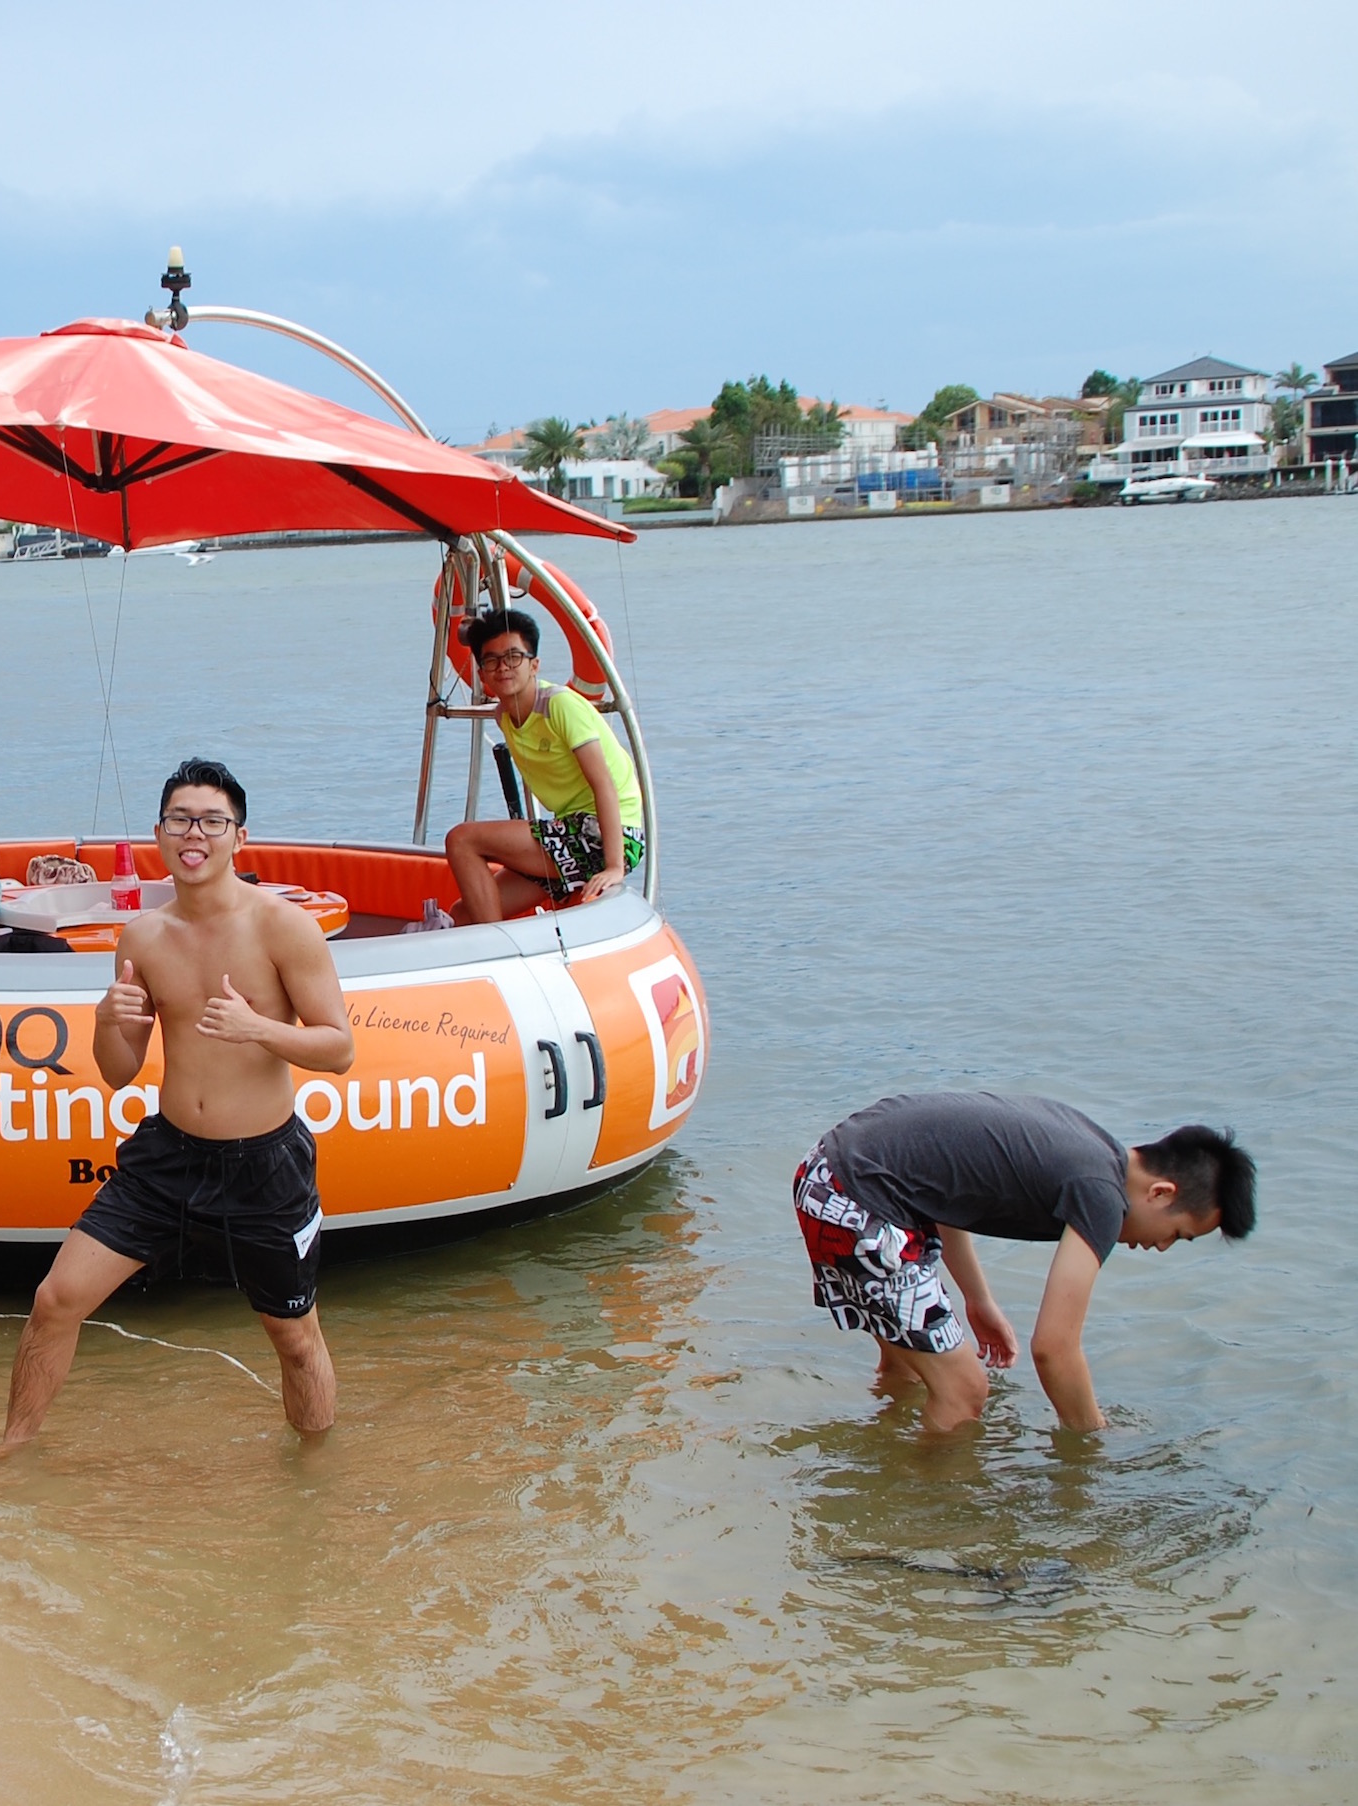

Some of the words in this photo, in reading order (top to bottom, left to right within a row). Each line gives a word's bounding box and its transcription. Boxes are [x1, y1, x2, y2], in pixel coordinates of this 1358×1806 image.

[365, 1006, 430, 1032] Licence
[436, 1012, 511, 1049] Required
[293, 1052, 486, 1134] ound
[68, 1159, 119, 1184] Bo
